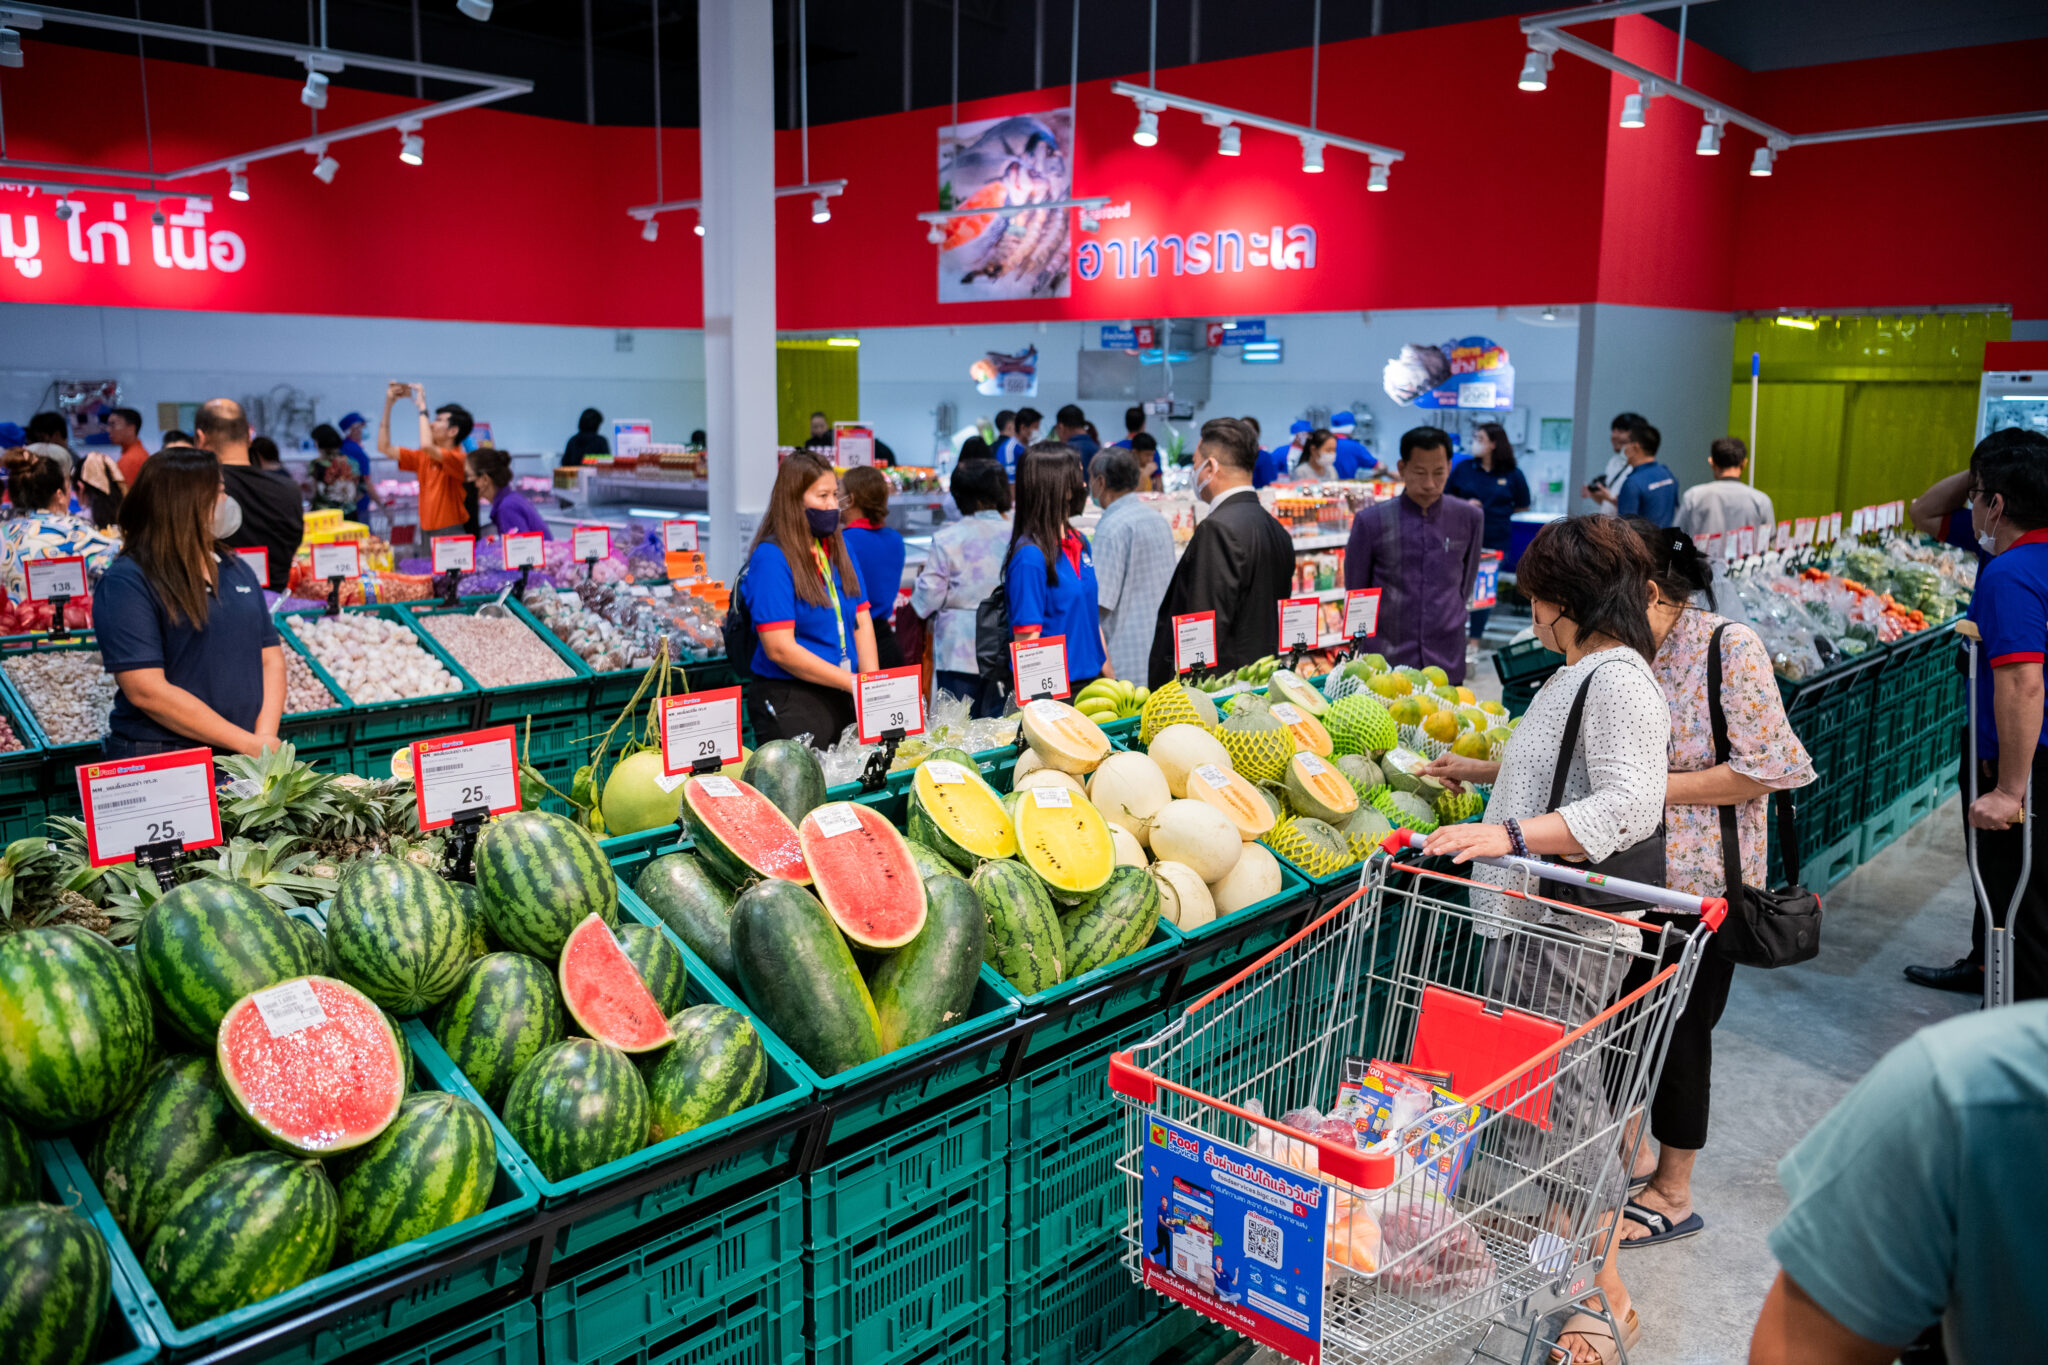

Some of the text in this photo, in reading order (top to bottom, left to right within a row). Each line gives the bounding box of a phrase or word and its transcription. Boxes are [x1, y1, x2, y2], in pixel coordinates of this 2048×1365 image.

[56, 200, 130, 266] ไก่
[152, 197, 246, 272] เนื้อ
[1078, 223, 1318, 281] อาหารทะเล
[52, 582, 71, 592] 138
[1041, 677, 1053, 690] 65
[890, 712, 904, 726] 39
[698, 740, 715, 756] 29
[462, 785, 484, 804] 25
[146, 820, 175, 843] 25
[1169, 1130, 1199, 1154] Food
[1167, 1143, 1199, 1162] Services
[1203, 1146, 1321, 1208] สั่งผ่านเว็บได้แล้ววันนี้
